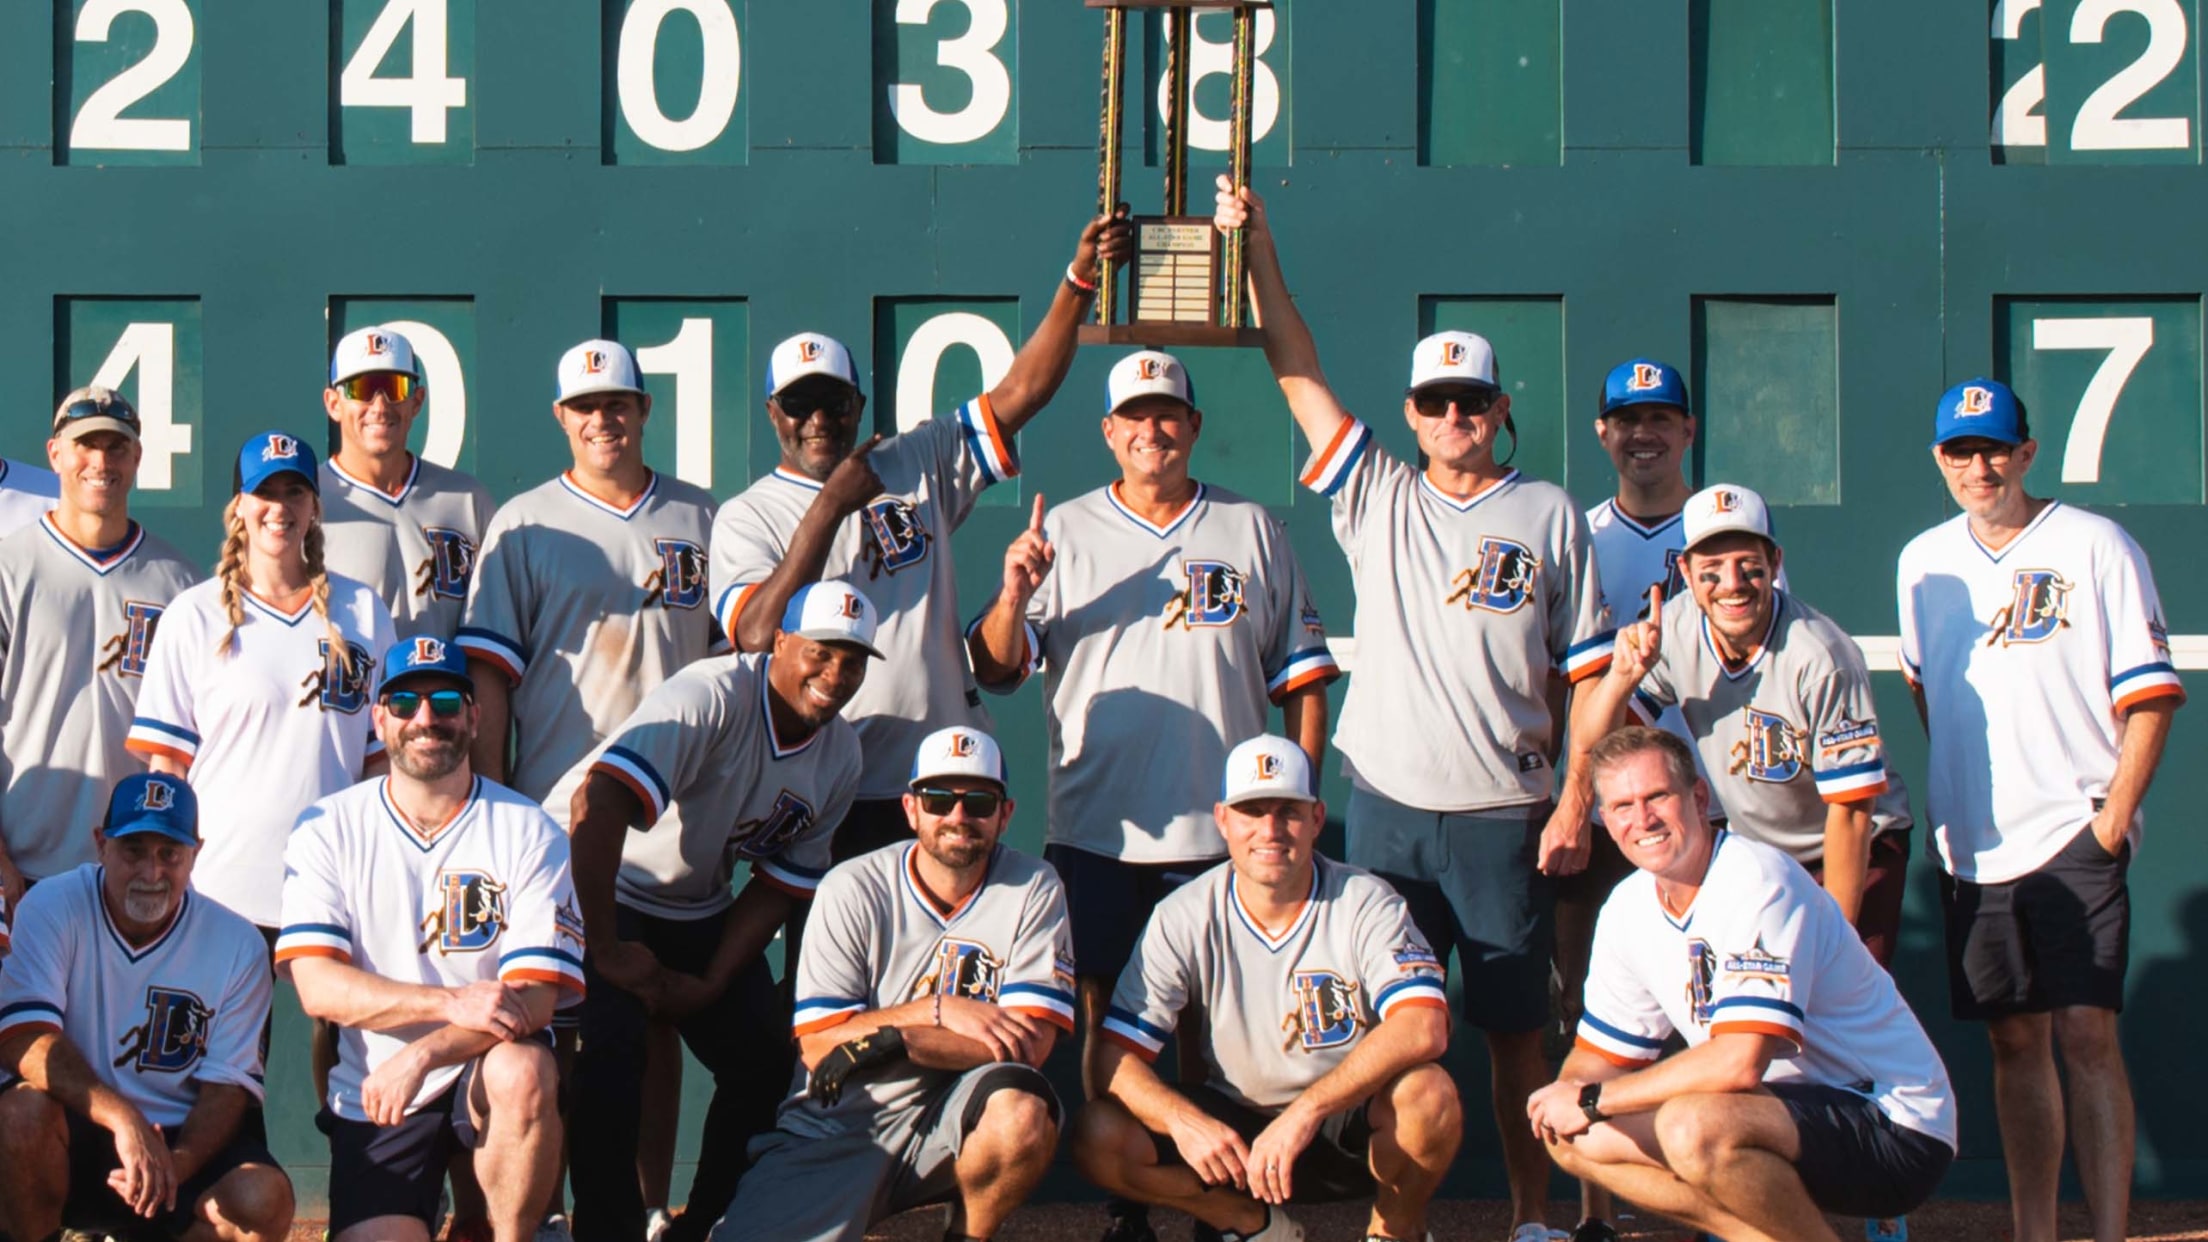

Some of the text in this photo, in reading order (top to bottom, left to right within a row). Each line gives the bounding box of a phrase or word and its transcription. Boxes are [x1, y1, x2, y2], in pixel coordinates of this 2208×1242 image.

[69, 0, 195, 152] 2
[340, 0, 467, 144] 4
[616, 0, 741, 152] 0
[888, 0, 1012, 145] 3
[1157, 2, 1280, 152] 8
[90, 322, 192, 491] 4
[634, 316, 713, 490] 1
[2033, 316, 2154, 484] 7
